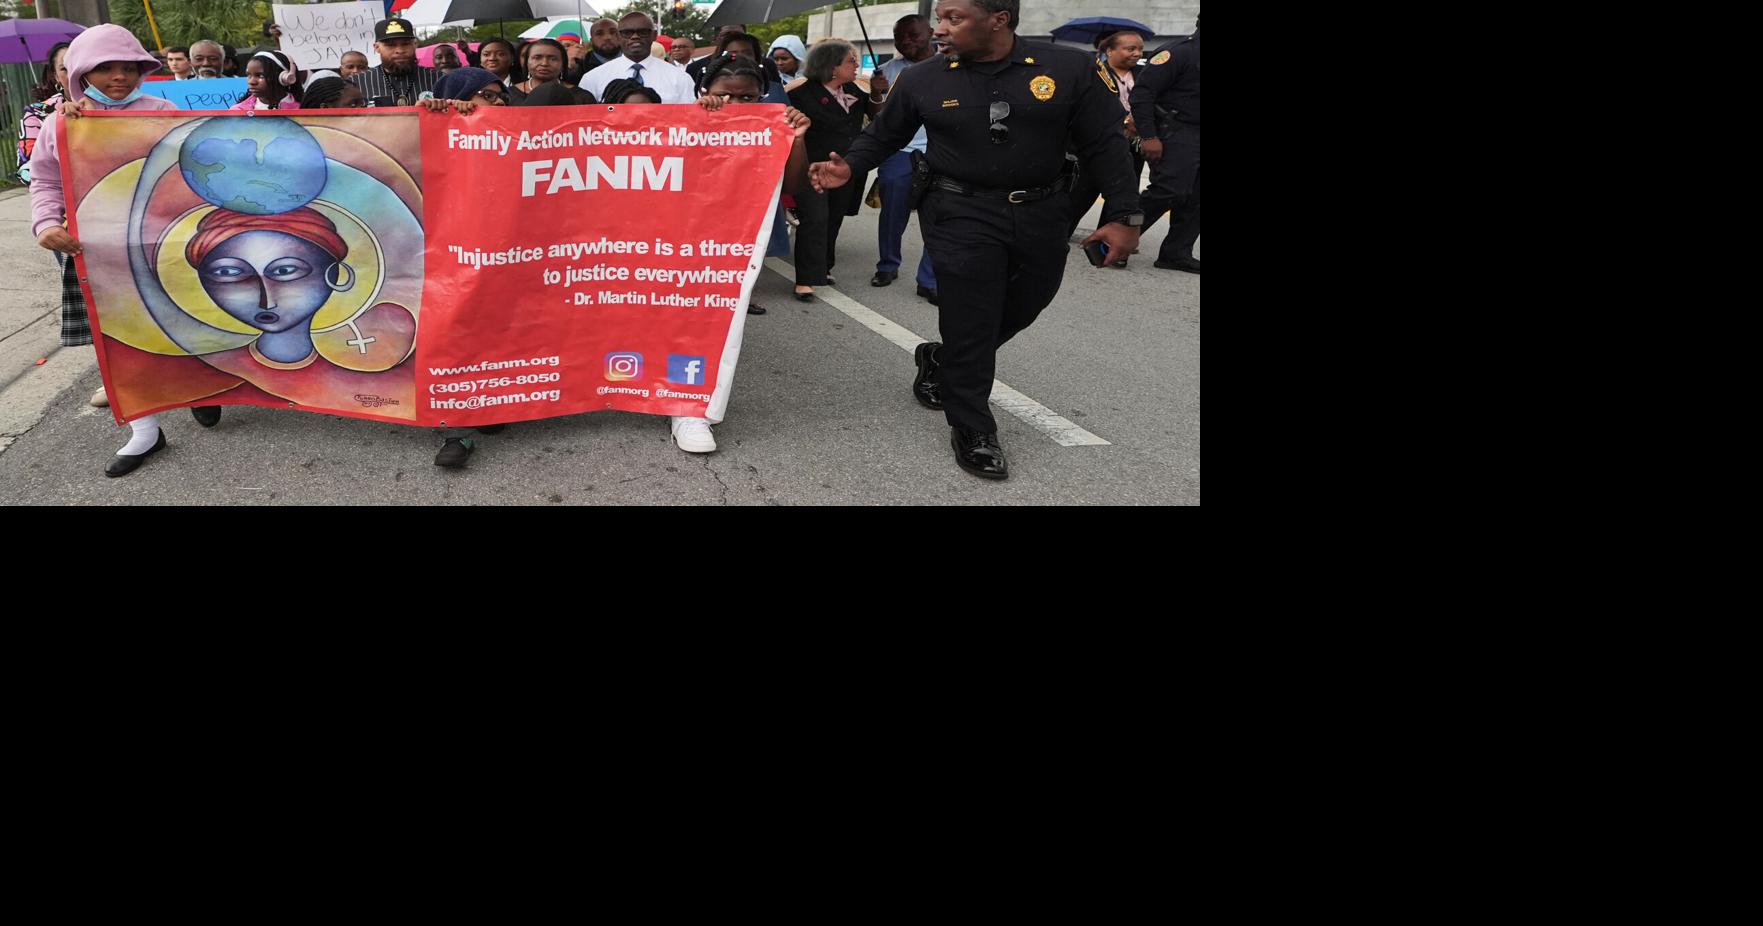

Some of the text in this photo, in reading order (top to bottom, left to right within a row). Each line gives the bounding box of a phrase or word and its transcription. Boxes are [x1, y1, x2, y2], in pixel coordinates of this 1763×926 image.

[280, 8, 377, 31] We don't
[288, 31, 374, 47] belong in
[448, 127, 772, 155] Family Action Network Movement
[521, 156, 684, 197] FANM
[448, 237, 755, 269] "Injustice anywhere is a threa
[543, 270, 561, 286] to
[564, 264, 629, 288] justice
[574, 292, 594, 306] Dr.
[598, 291, 647, 305] Martin
[651, 293, 701, 308] Luther
[704, 294, 738, 312] King
[429, 354, 560, 376] www.fanm.org
[429, 371, 561, 395] (305)756-8050
[597, 386, 650, 398] @fanmorg
[430, 388, 561, 410] info@fanm.org
[656, 388, 711, 402] @fanmorg
